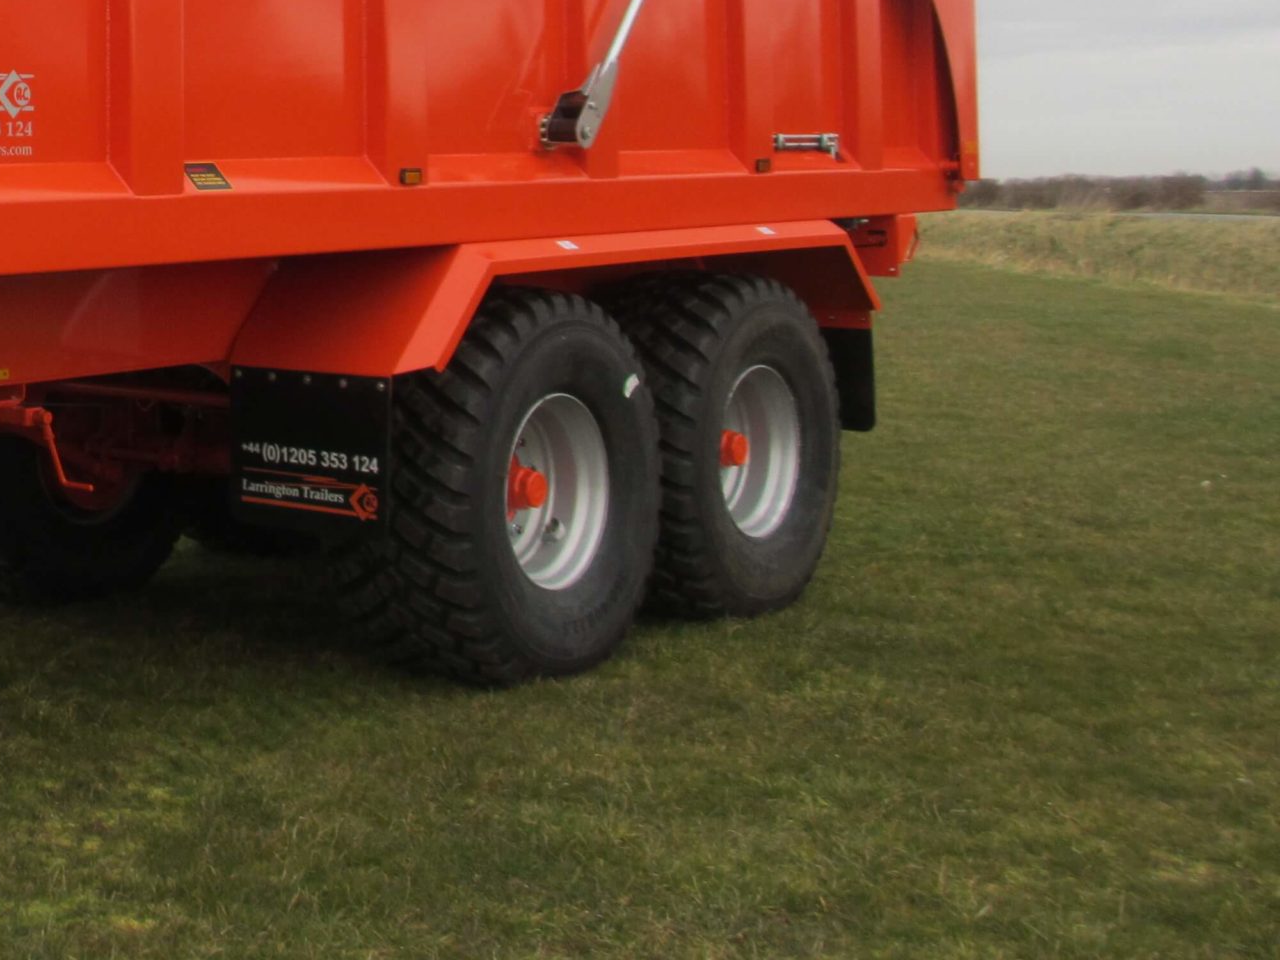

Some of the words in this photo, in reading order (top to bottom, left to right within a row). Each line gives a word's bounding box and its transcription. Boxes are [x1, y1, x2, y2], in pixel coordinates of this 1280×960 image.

[6, 121, 33, 137] 124
[241, 442, 261, 454] +44
[262, 443, 317, 466] (0)1205
[321, 451, 348, 470] 353
[353, 456, 379, 474] 124
[241, 478, 300, 499] Larrington
[303, 486, 345, 504] Trailers
